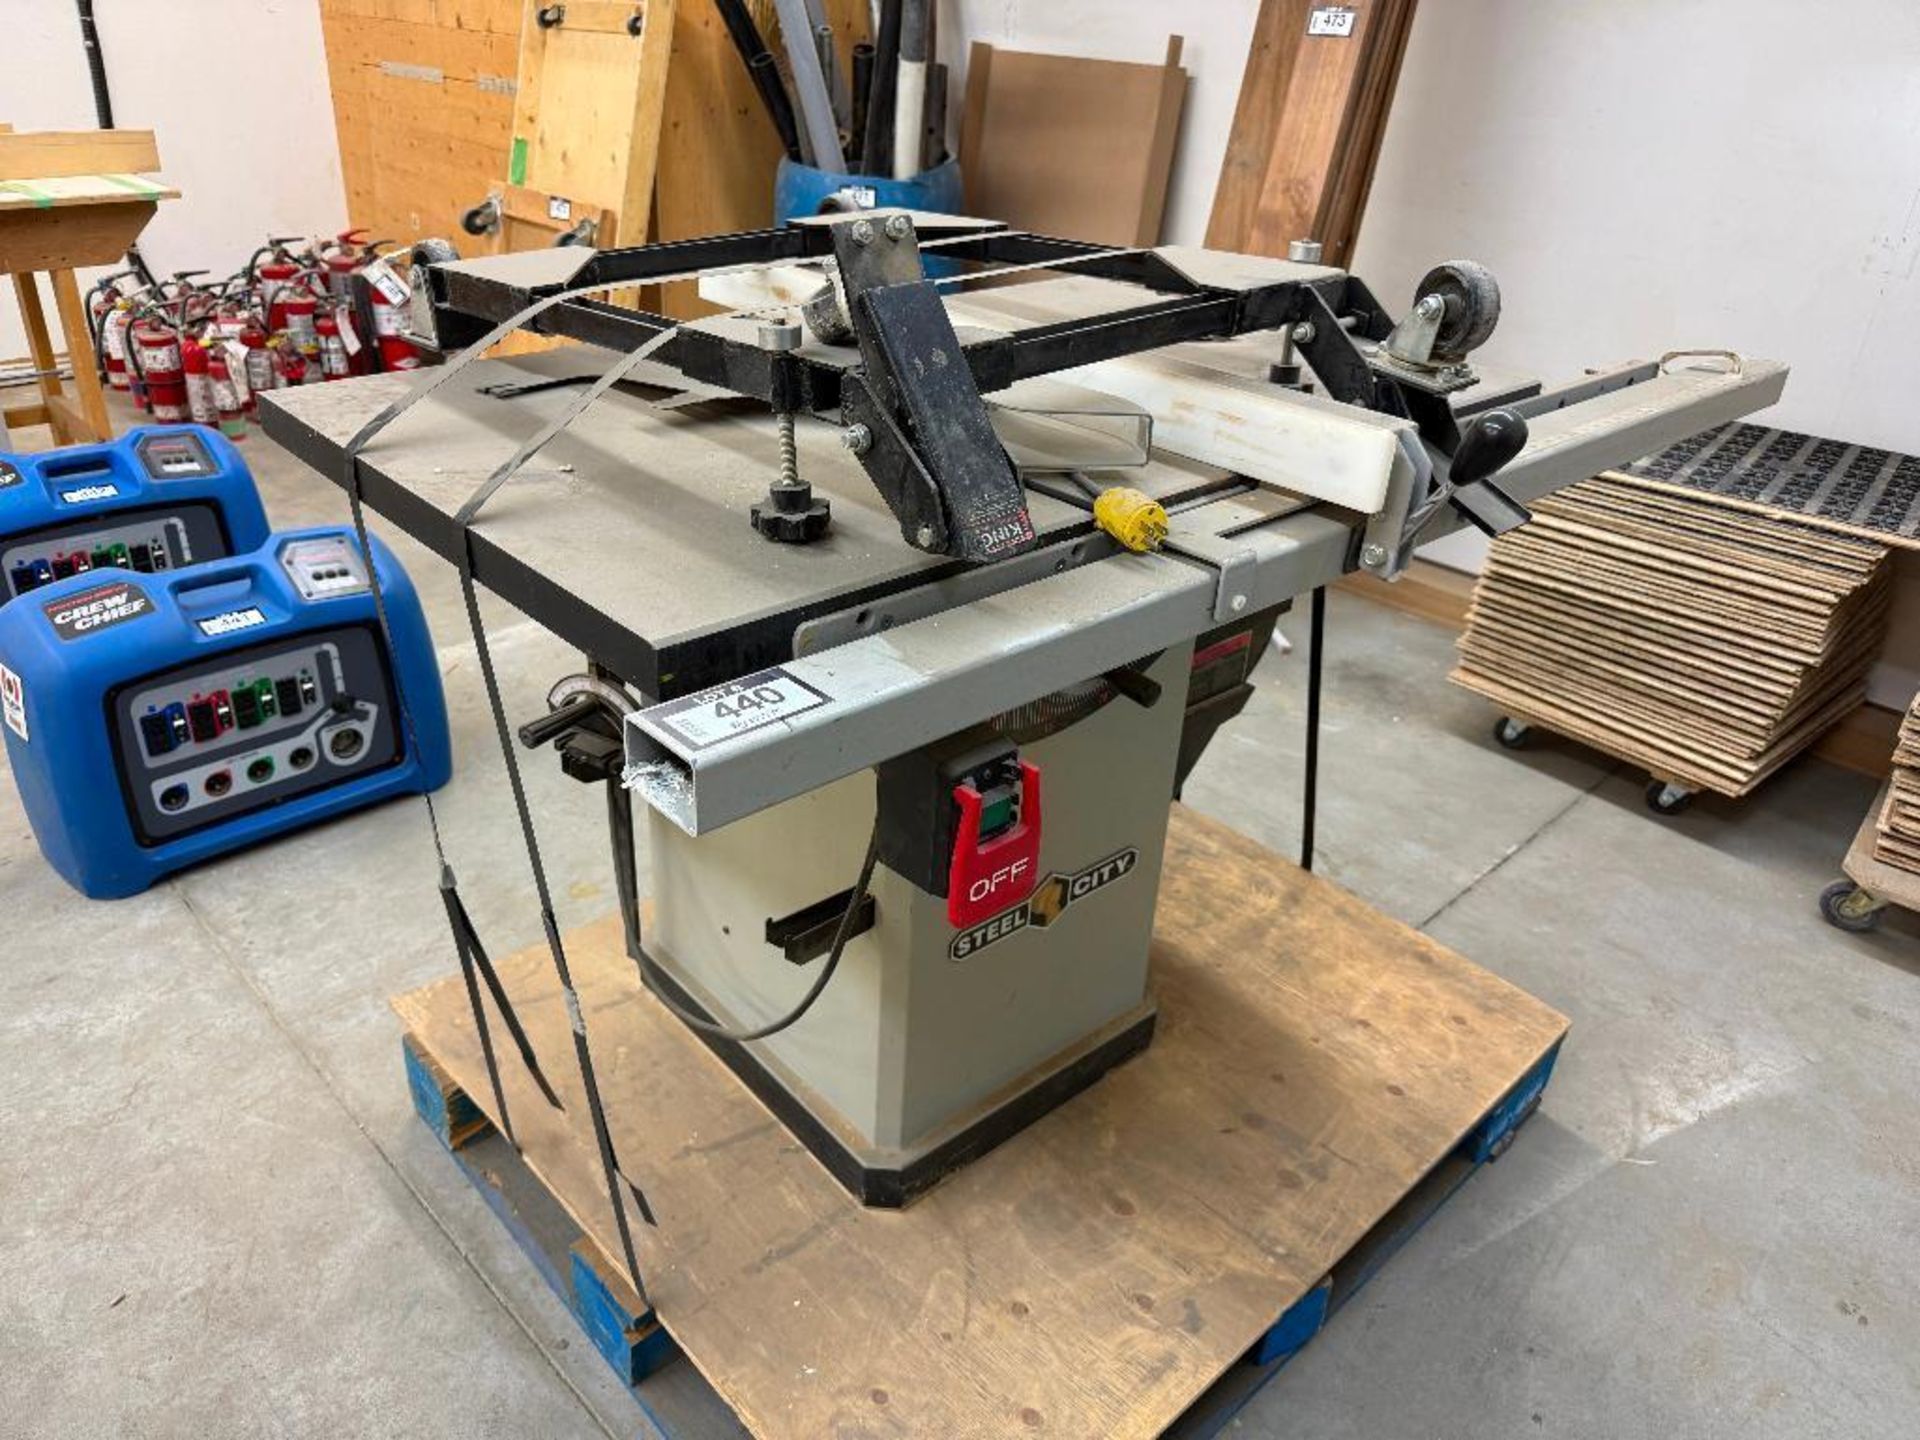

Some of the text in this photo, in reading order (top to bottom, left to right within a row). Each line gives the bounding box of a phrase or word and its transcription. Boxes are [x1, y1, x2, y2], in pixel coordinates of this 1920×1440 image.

[1324, 14, 1346, 28] 473
[980, 521, 1023, 549] KING
[53, 592, 129, 625] CREW
[74, 598, 145, 630] CHIEF
[714, 686, 786, 719] 440
[969, 856, 1030, 902] OFF
[956, 853, 1132, 957] STEEL CITY
